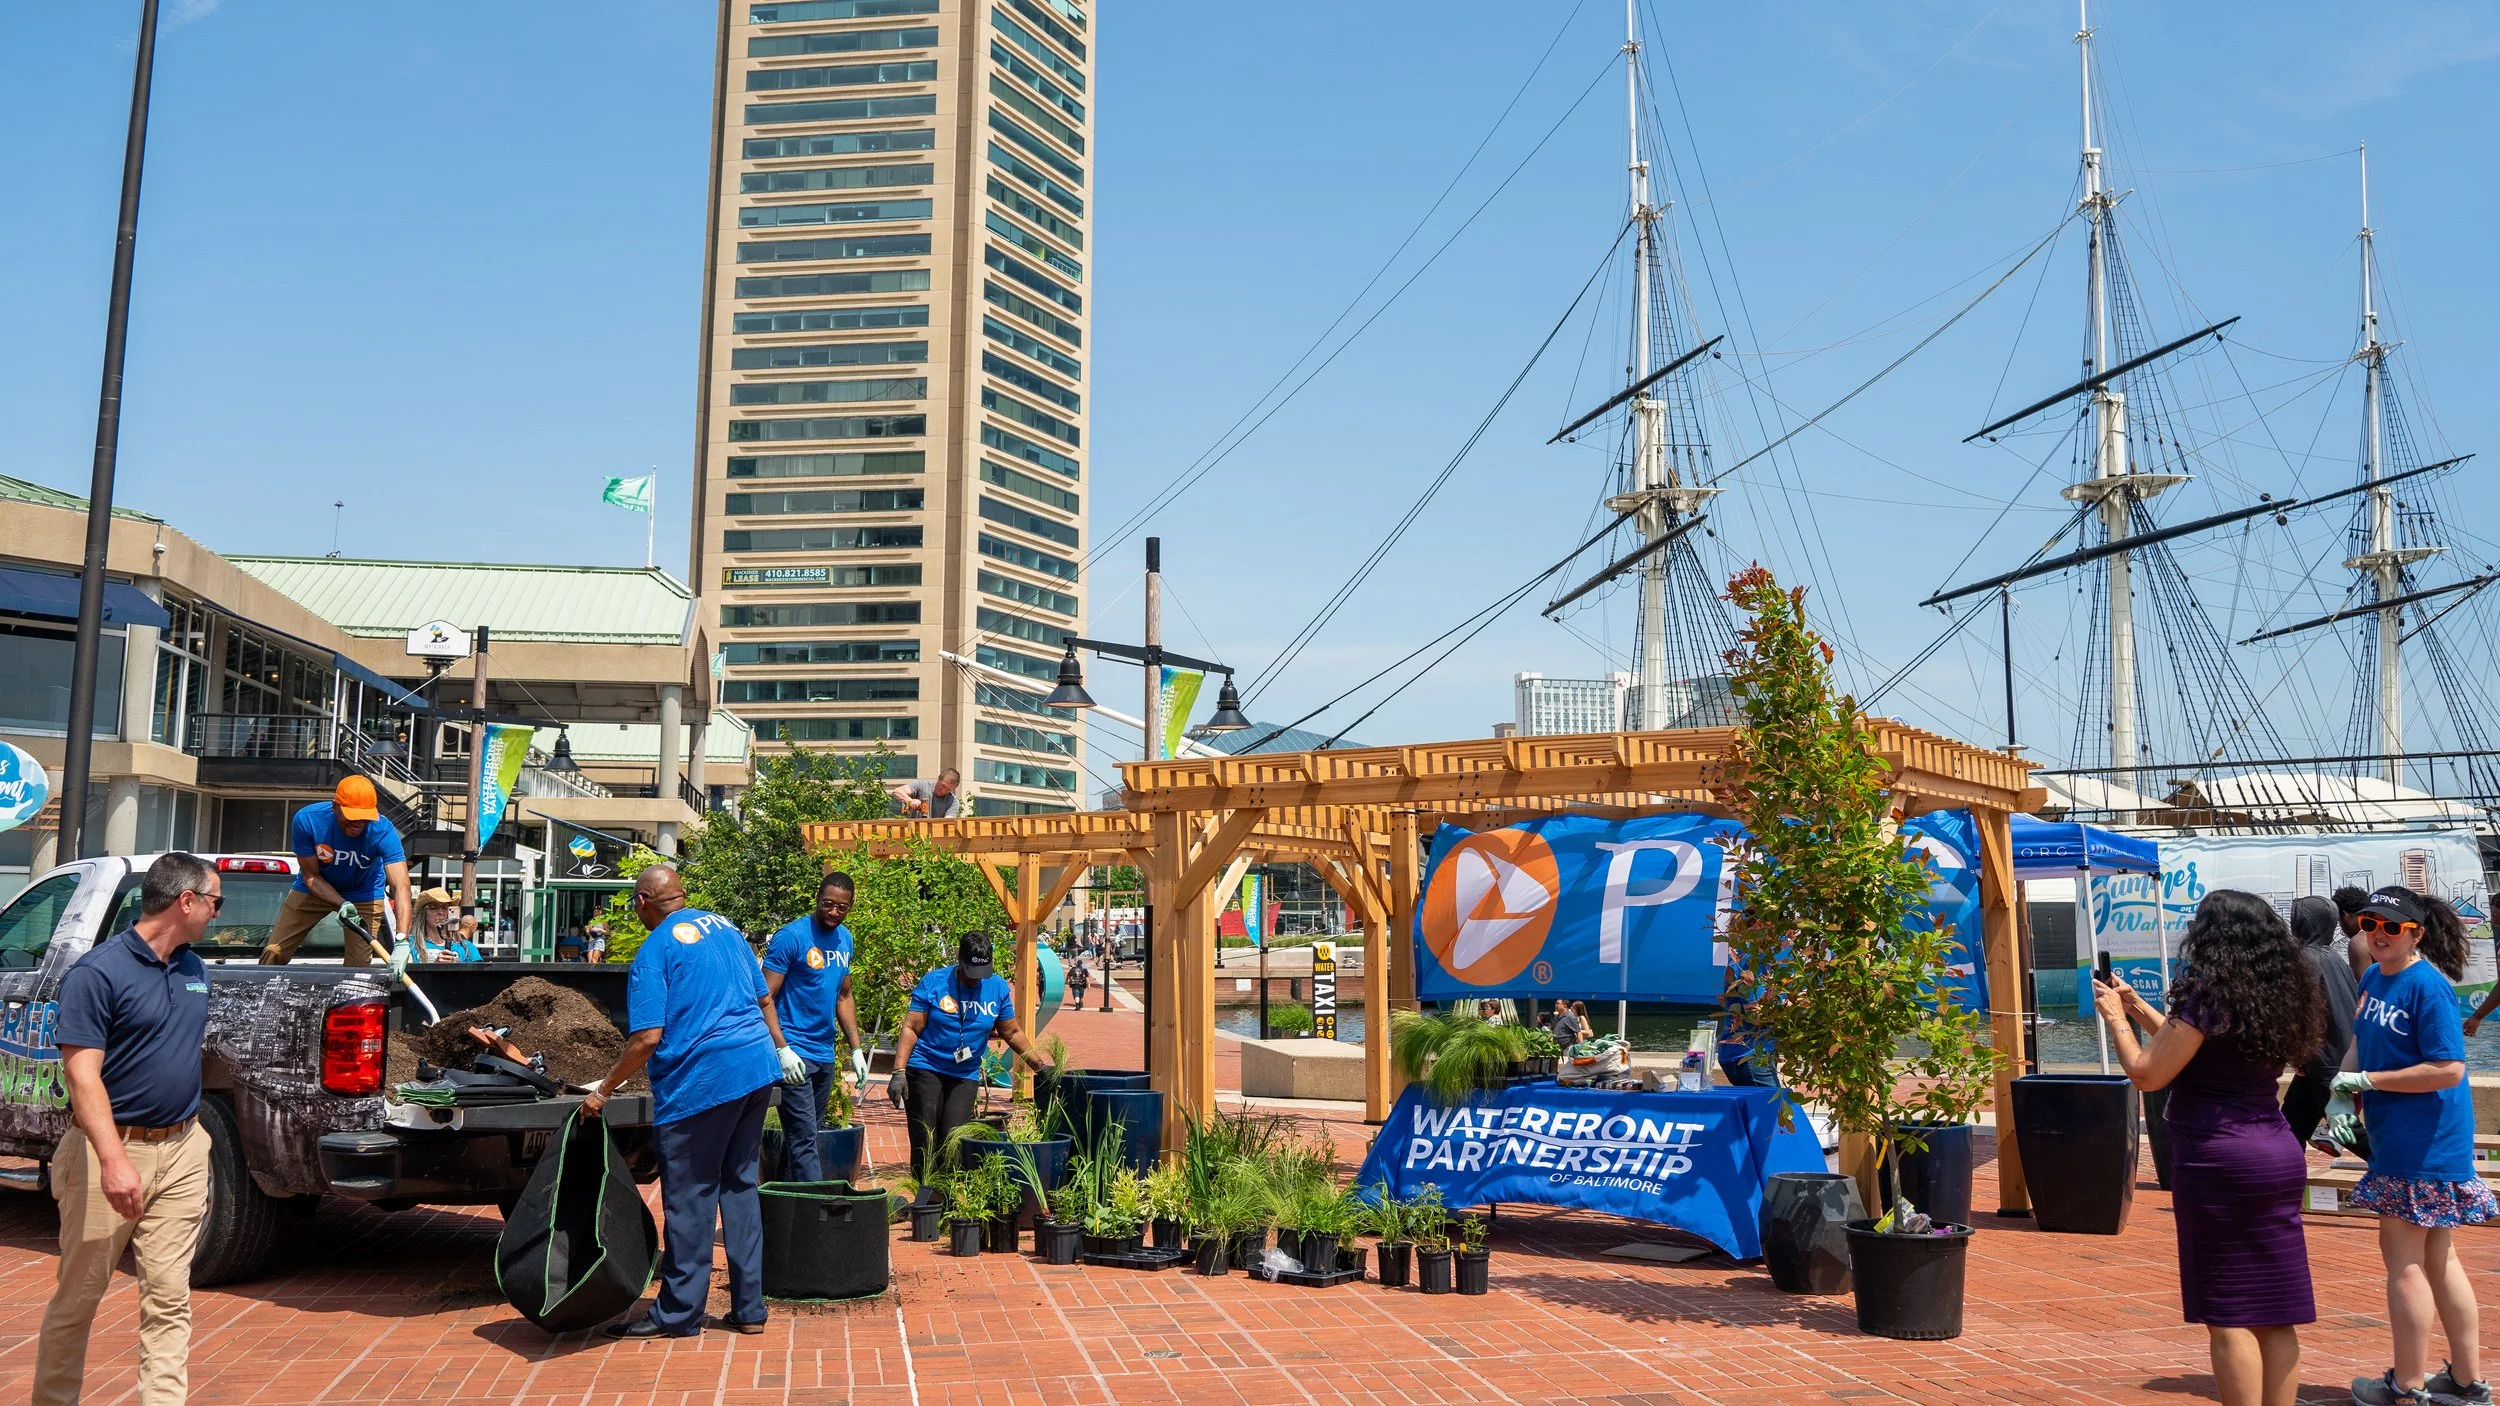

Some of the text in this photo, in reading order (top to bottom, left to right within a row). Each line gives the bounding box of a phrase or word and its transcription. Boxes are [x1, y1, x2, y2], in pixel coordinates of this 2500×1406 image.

[733, 574, 759, 582] LEASE
[765, 569, 826, 578] 410.821.8585
[483, 737, 497, 815] WATERFRONT
[489, 738, 505, 814] PARTNERSHIP
[2379, 894, 2400, 906] PNC
[1314, 963, 1335, 972] WATER
[1314, 972, 1335, 1014] TAXI
[2132, 980, 2159, 989] SCAN
[960, 1000, 998, 1017] PNC
[2364, 996, 2410, 1036] PNC
[1412, 1104, 1704, 1153] WATERFRONT
[1405, 1137, 1693, 1181] PARTNERSHIP
[1549, 1172, 1664, 1196] OF BALTIMORE
